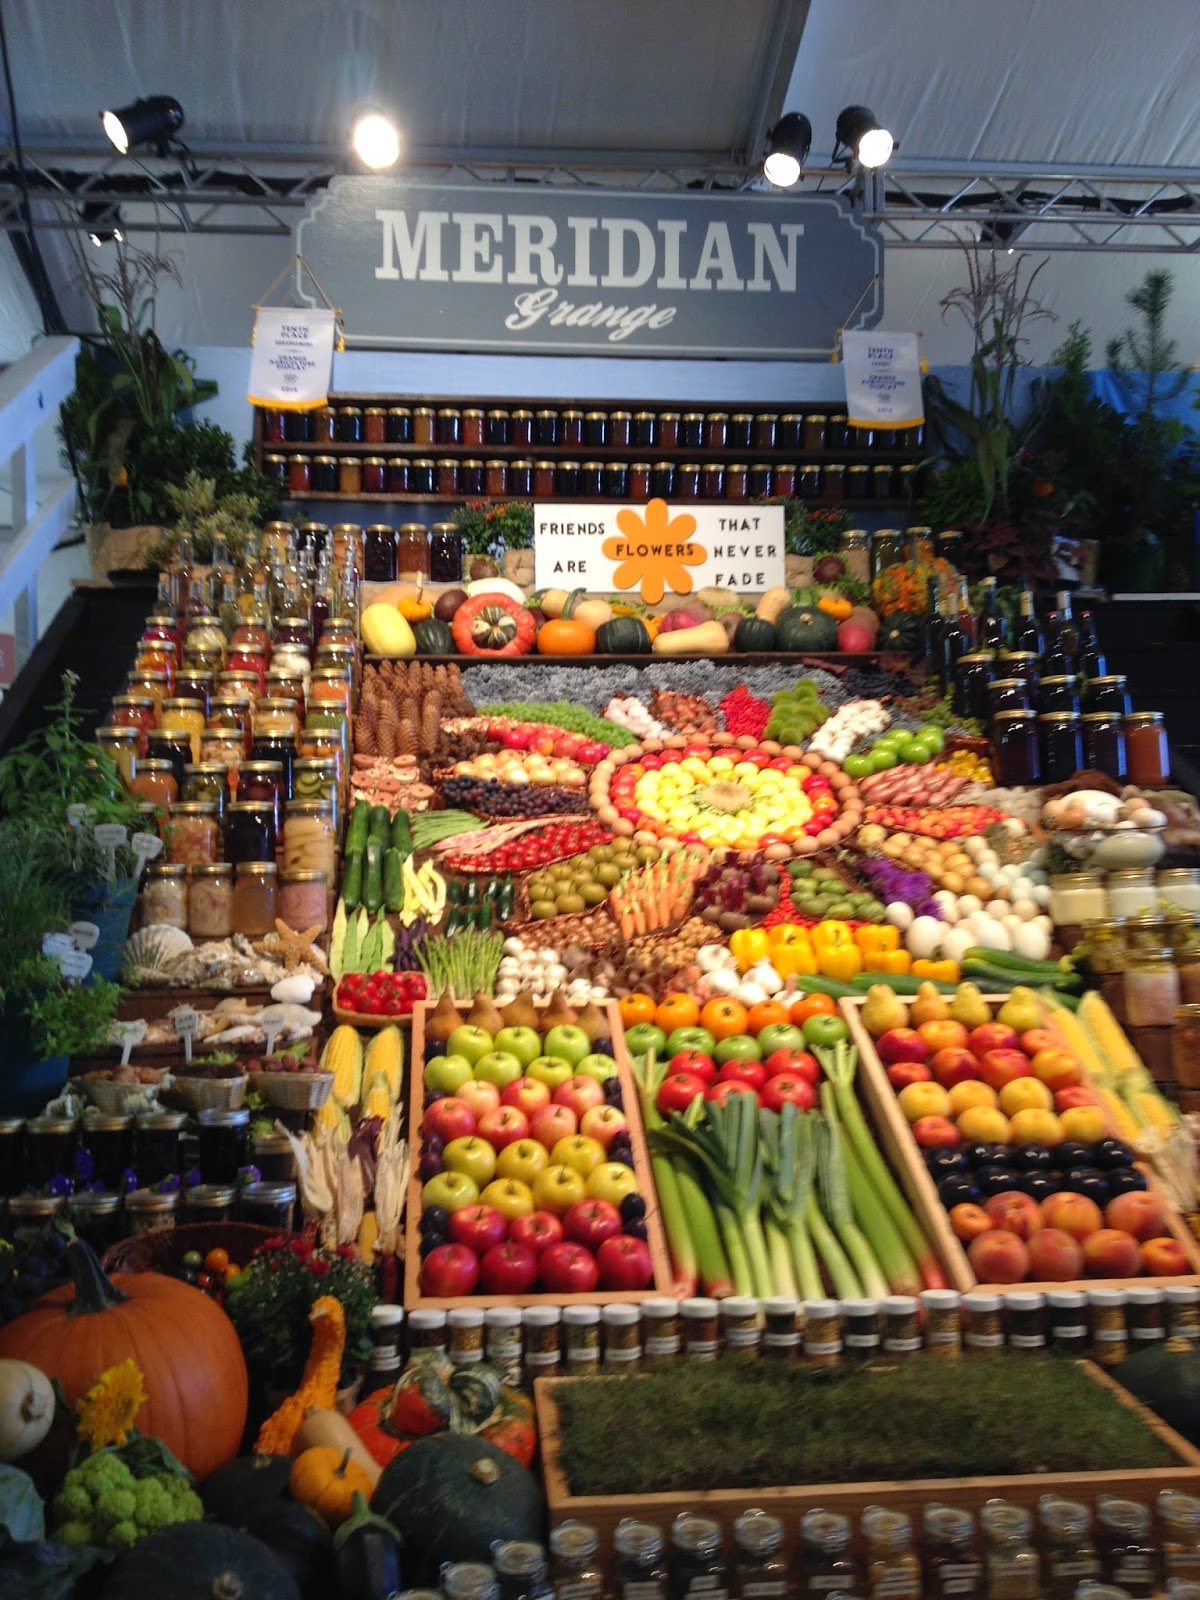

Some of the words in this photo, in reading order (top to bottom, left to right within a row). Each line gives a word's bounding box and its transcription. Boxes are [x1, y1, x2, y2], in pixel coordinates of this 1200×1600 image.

[374, 208, 805, 293] MERIDIAN
[504, 287, 677, 342] Grange
[539, 522, 605, 535] FRIENDS
[718, 517, 761, 531] THAT
[616, 543, 694, 557] FLOWERS
[713, 545, 777, 558] NEVER
[553, 560, 587, 573] ARE
[715, 572, 765, 586] FADE
